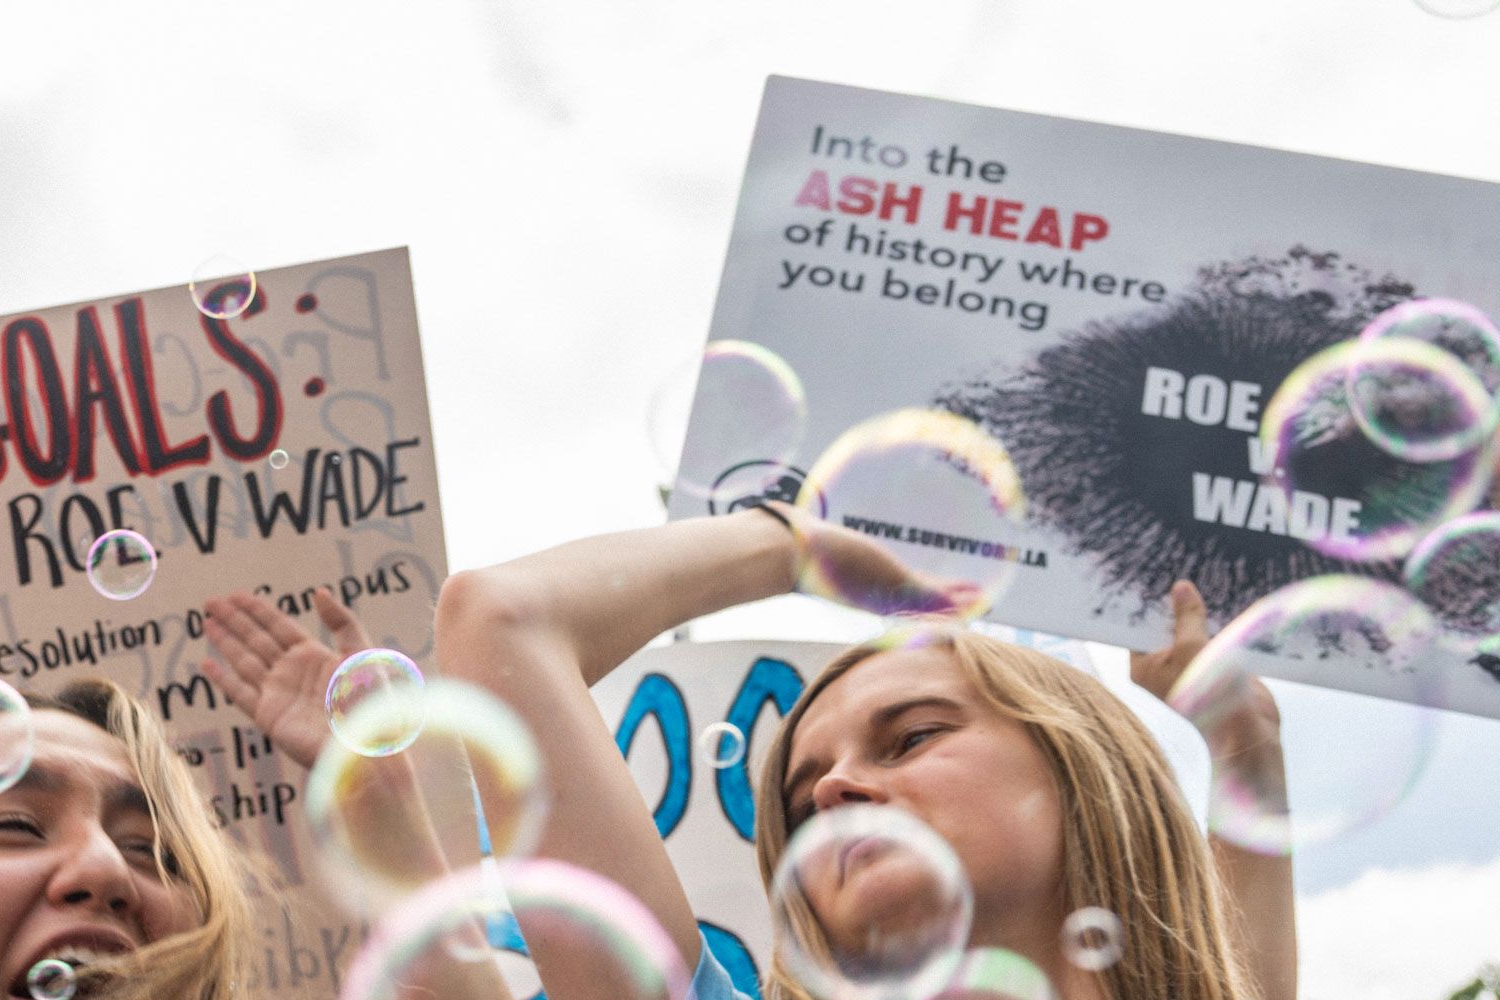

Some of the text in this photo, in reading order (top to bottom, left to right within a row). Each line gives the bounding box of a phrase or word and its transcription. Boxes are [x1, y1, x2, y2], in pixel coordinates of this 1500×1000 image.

[811, 125, 1008, 184] Into the
[795, 169, 1110, 252] ASH HEAP
[778, 259, 1049, 332] you belong
[785, 219, 1168, 303] of history where
[1142, 366, 1262, 432] ROE
[8, 486, 162, 589] ROE
[174, 474, 221, 553] V
[244, 439, 425, 540] WADE
[1192, 472, 1362, 543] WADE
